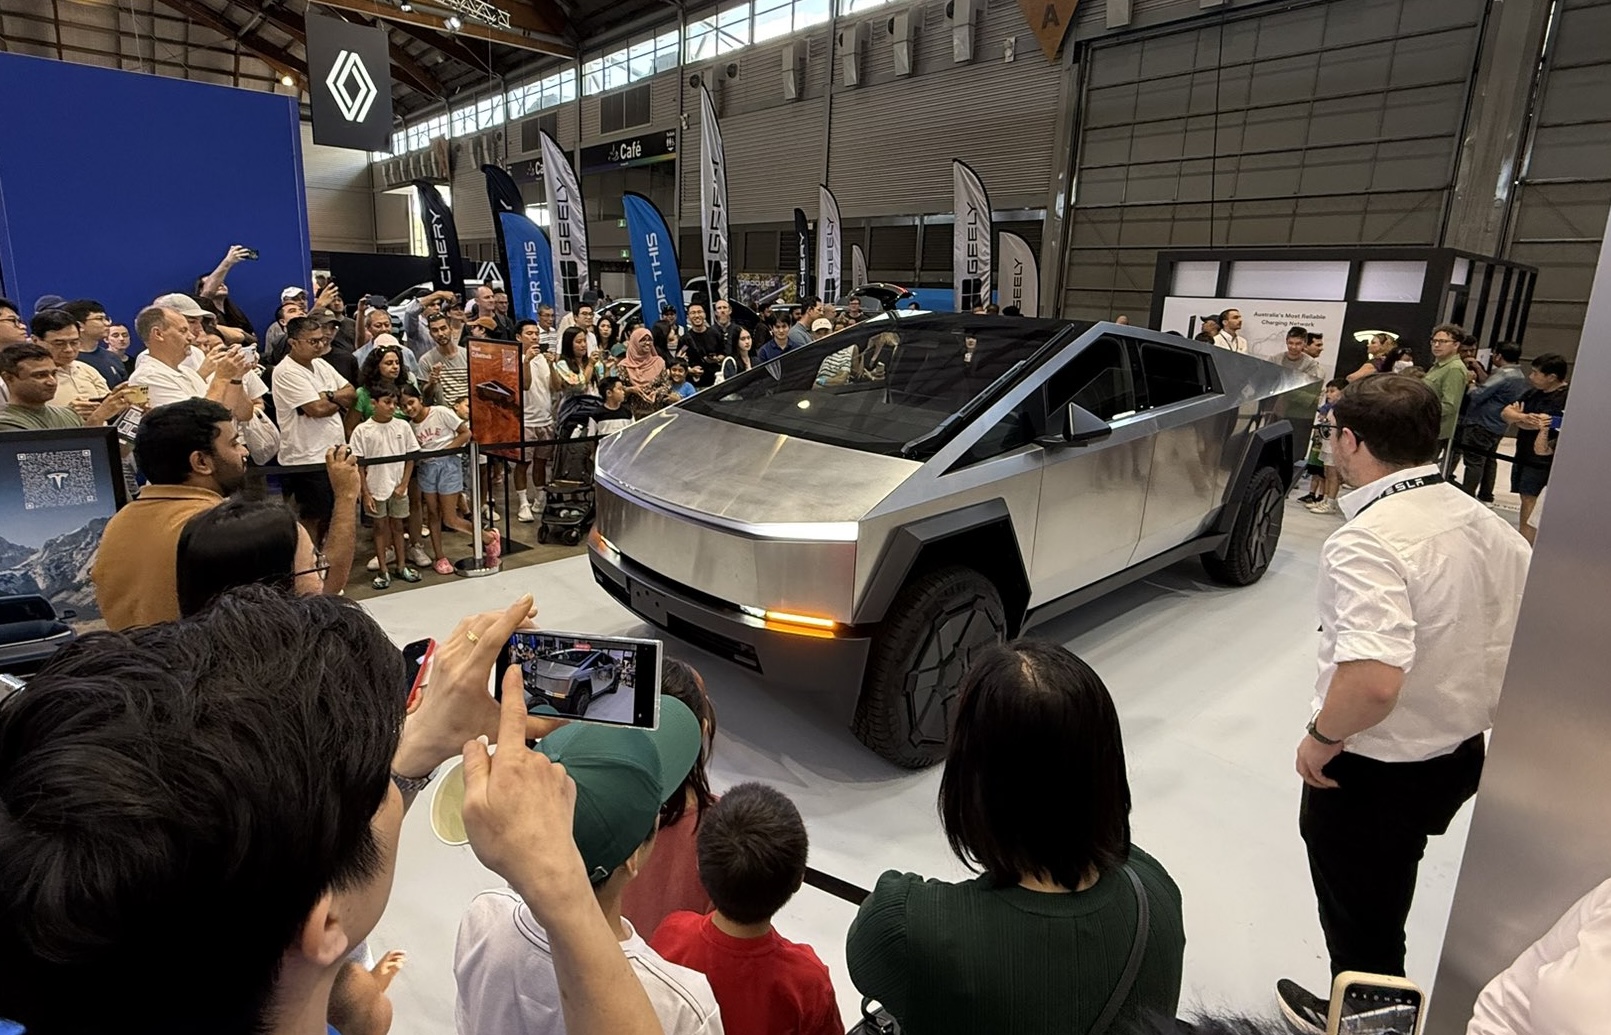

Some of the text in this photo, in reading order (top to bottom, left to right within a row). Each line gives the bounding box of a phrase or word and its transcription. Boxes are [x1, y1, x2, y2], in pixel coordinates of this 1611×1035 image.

[1042, 4, 1060, 29] A
[620, 140, 641, 160] Café
[556, 177, 571, 256] GEELY
[966, 201, 978, 275] GEELY
[429, 208, 451, 285] CHERY
[524, 241, 539, 278] THIS
[645, 232, 662, 282] THIS
[826, 216, 834, 275] GEELY
[1378, 477, 1425, 498] ESLA
